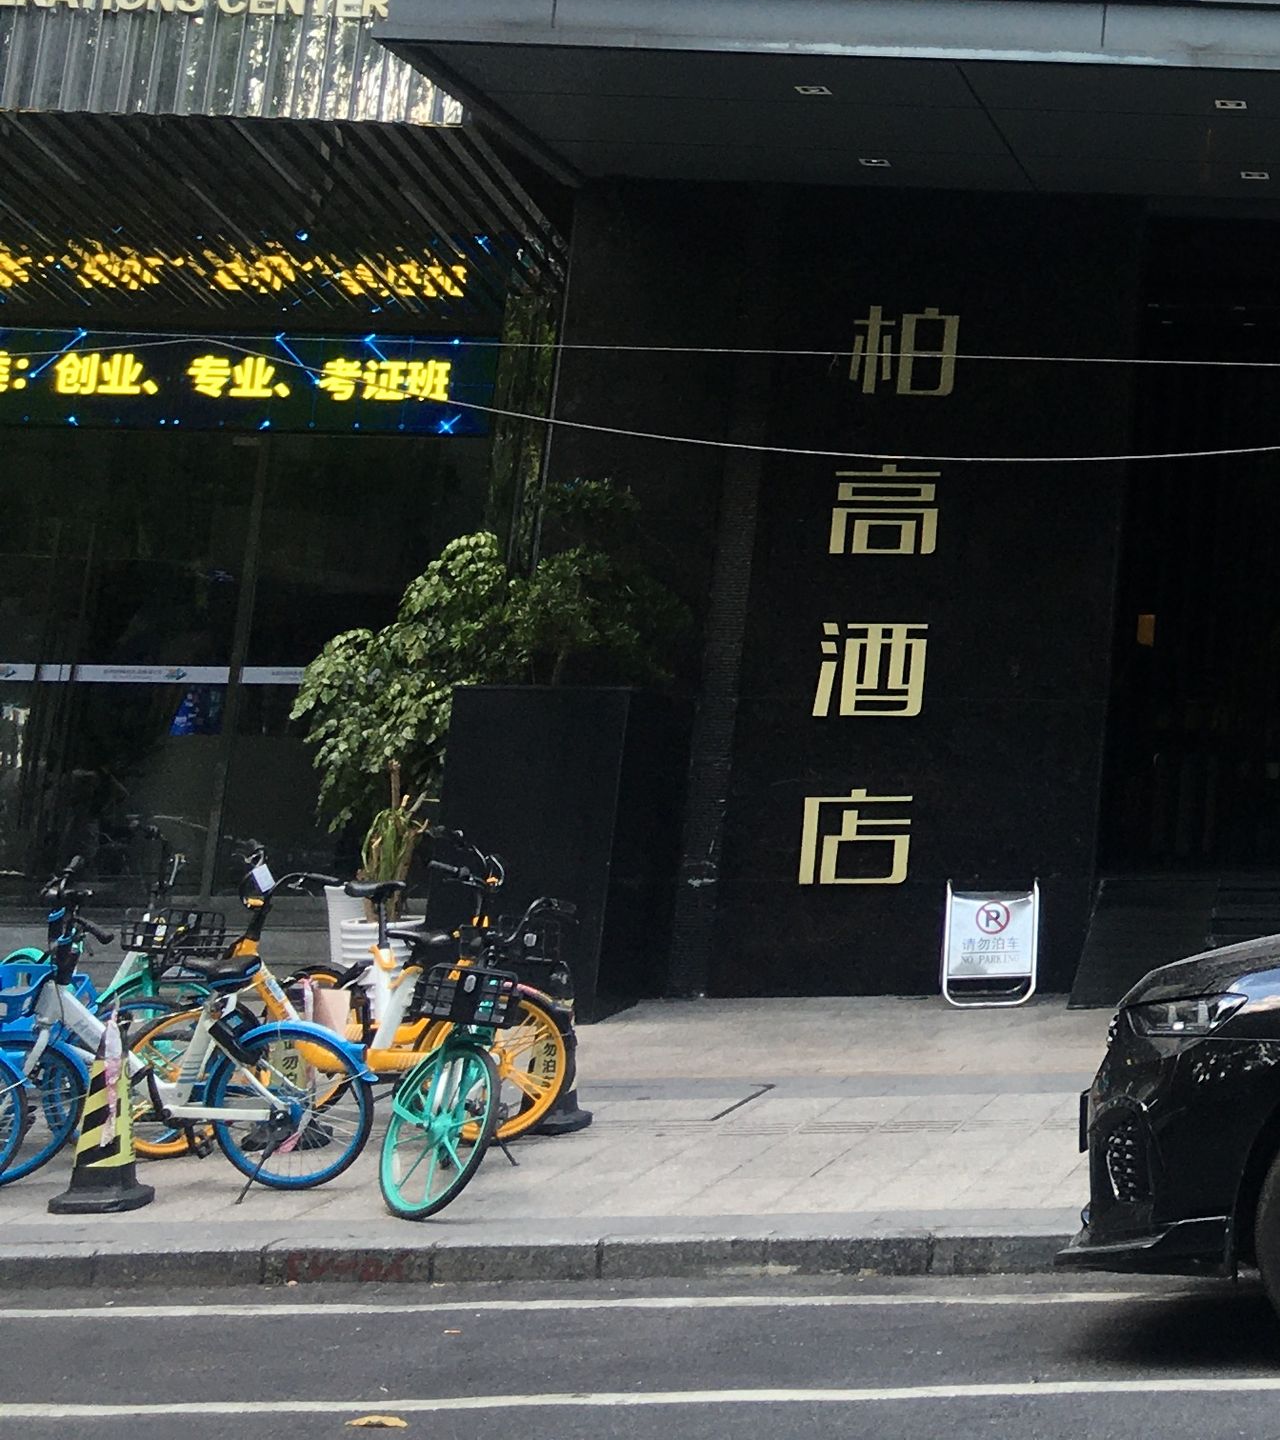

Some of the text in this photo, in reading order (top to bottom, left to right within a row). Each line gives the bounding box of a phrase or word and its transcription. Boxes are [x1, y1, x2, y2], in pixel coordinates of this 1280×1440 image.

[799, 305, 960, 886] 柏高酒店
[962, 937, 1020, 951] 请勿泊车
